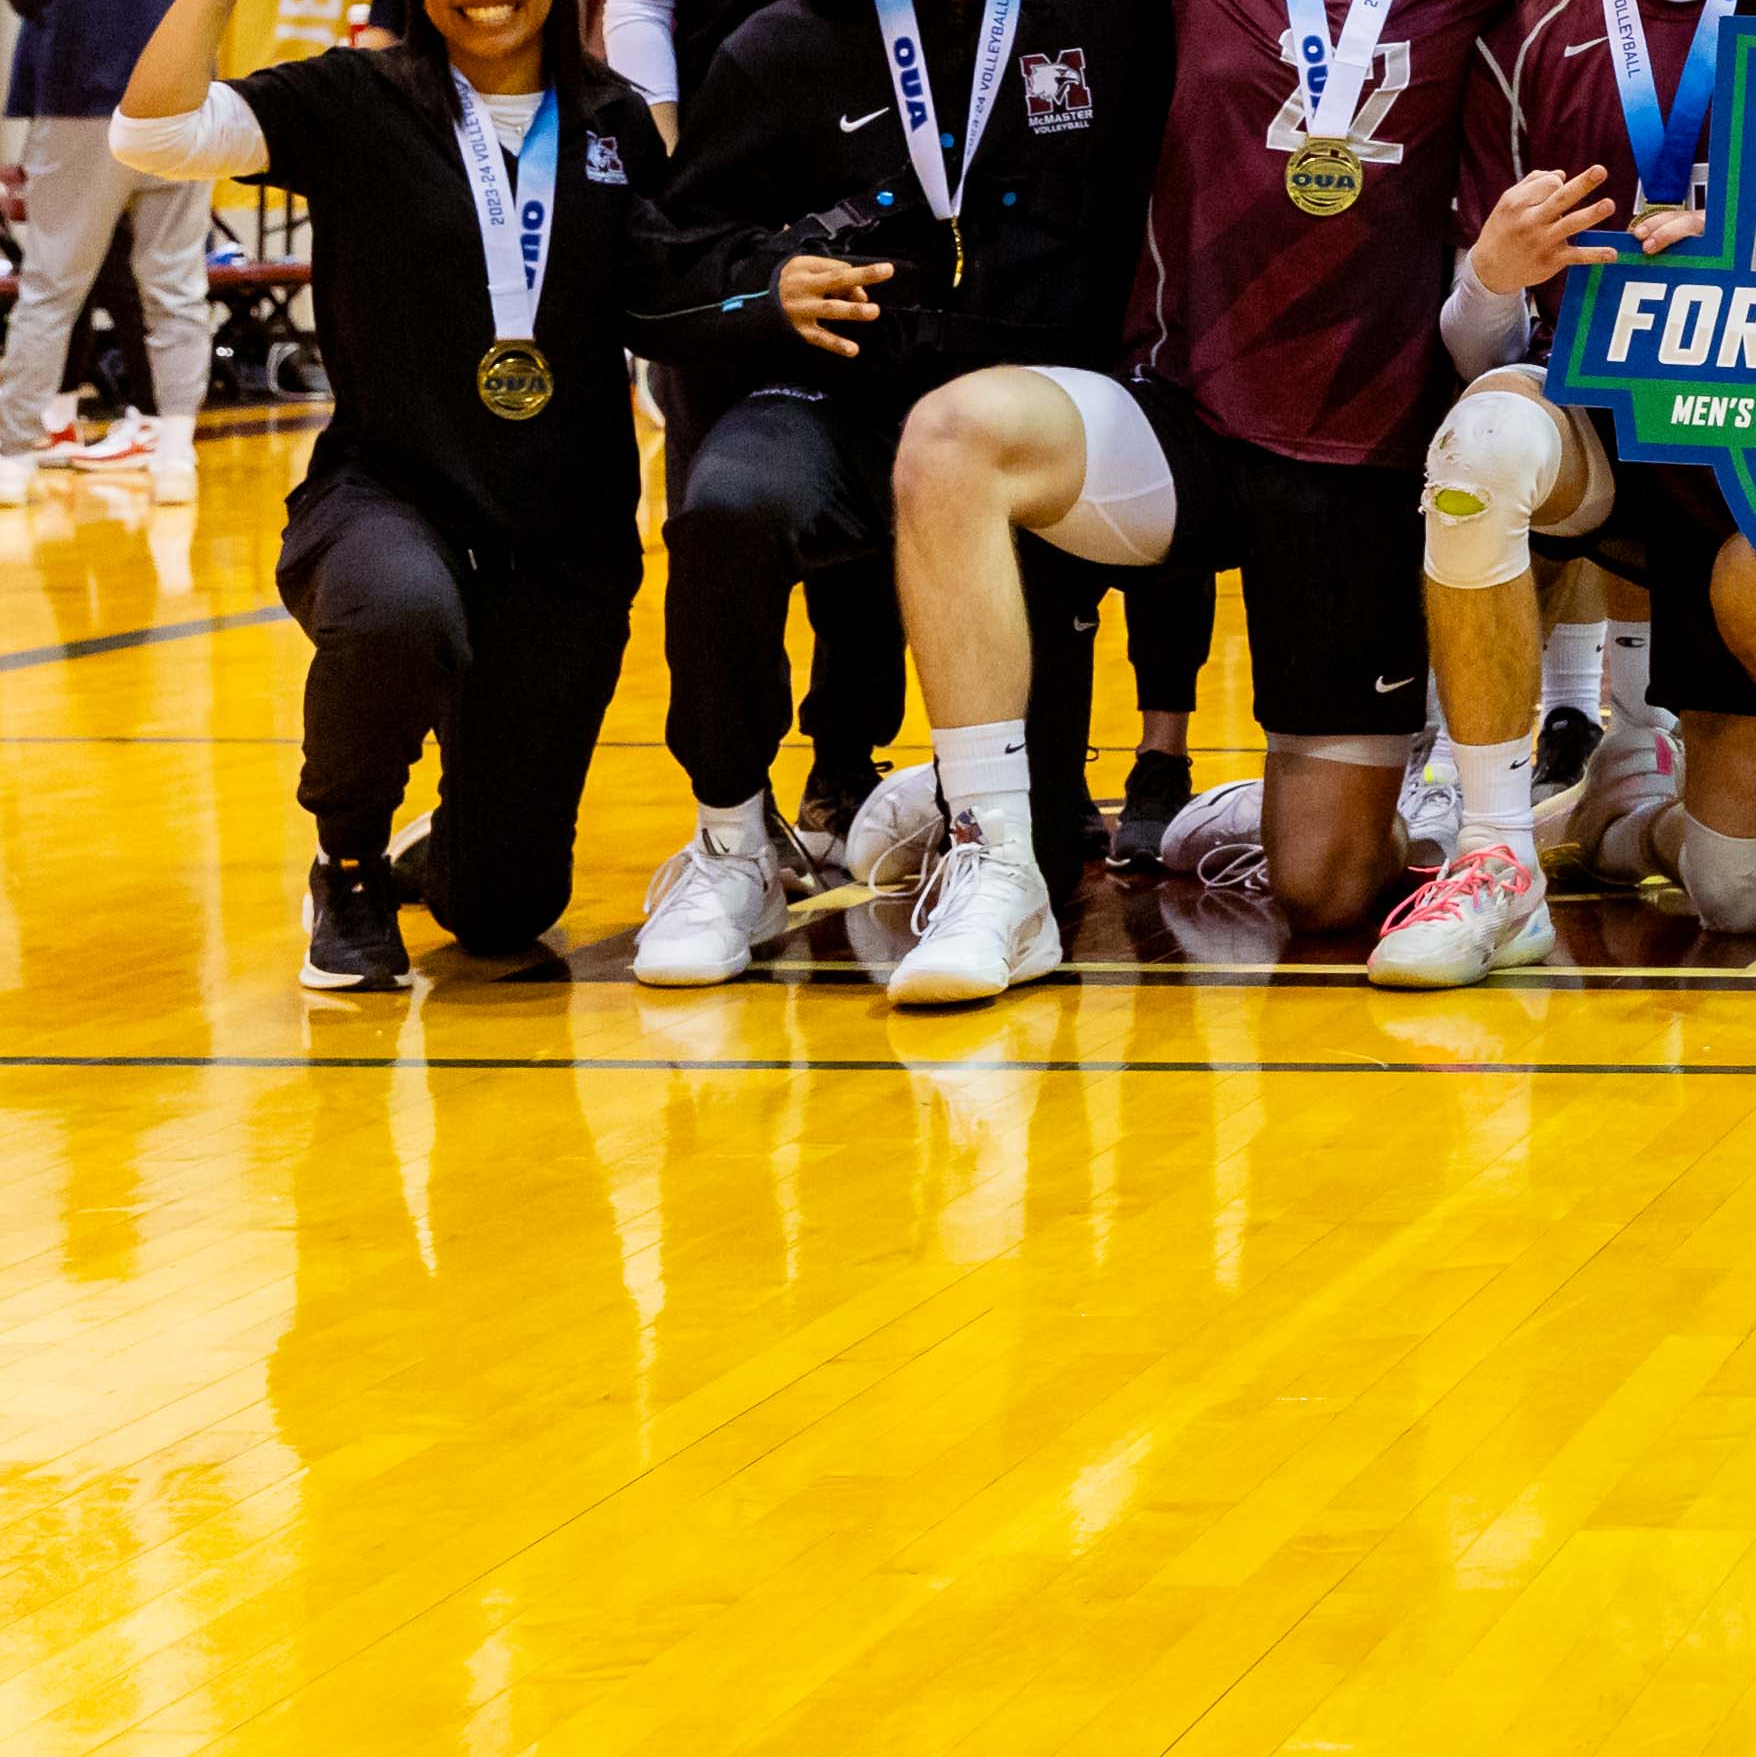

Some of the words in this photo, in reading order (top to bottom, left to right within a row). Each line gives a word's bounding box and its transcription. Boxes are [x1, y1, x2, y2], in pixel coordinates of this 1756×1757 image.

[893, 35, 928, 133] OUA
[1027, 108, 1094, 128] McMASTER
[1033, 120, 1091, 136] VOLLEYBALL
[1291, 172, 1356, 190] OUA
[1670, 394, 1754, 429] MEN'S
